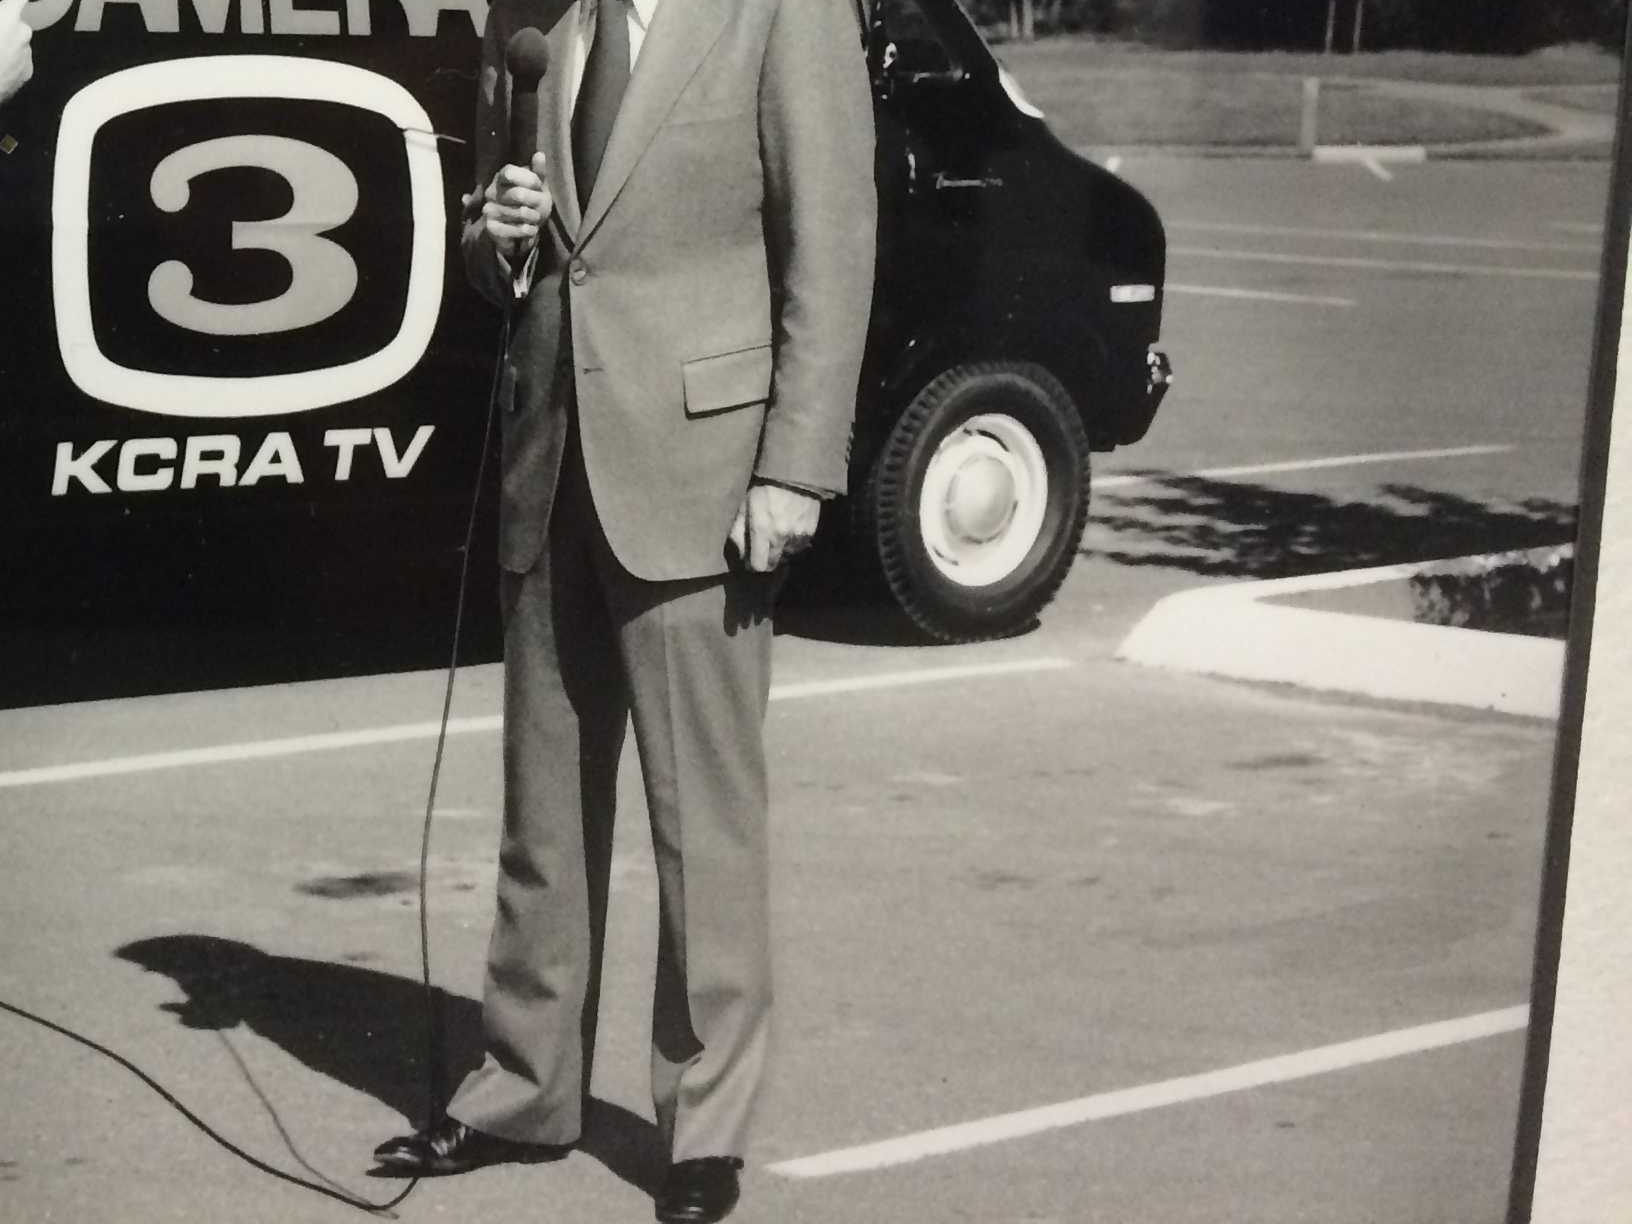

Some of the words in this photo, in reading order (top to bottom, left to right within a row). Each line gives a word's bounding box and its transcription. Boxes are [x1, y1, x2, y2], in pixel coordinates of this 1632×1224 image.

[148, 134, 358, 336] 3
[51, 431, 304, 496] KCRA
[322, 425, 436, 480] TV
